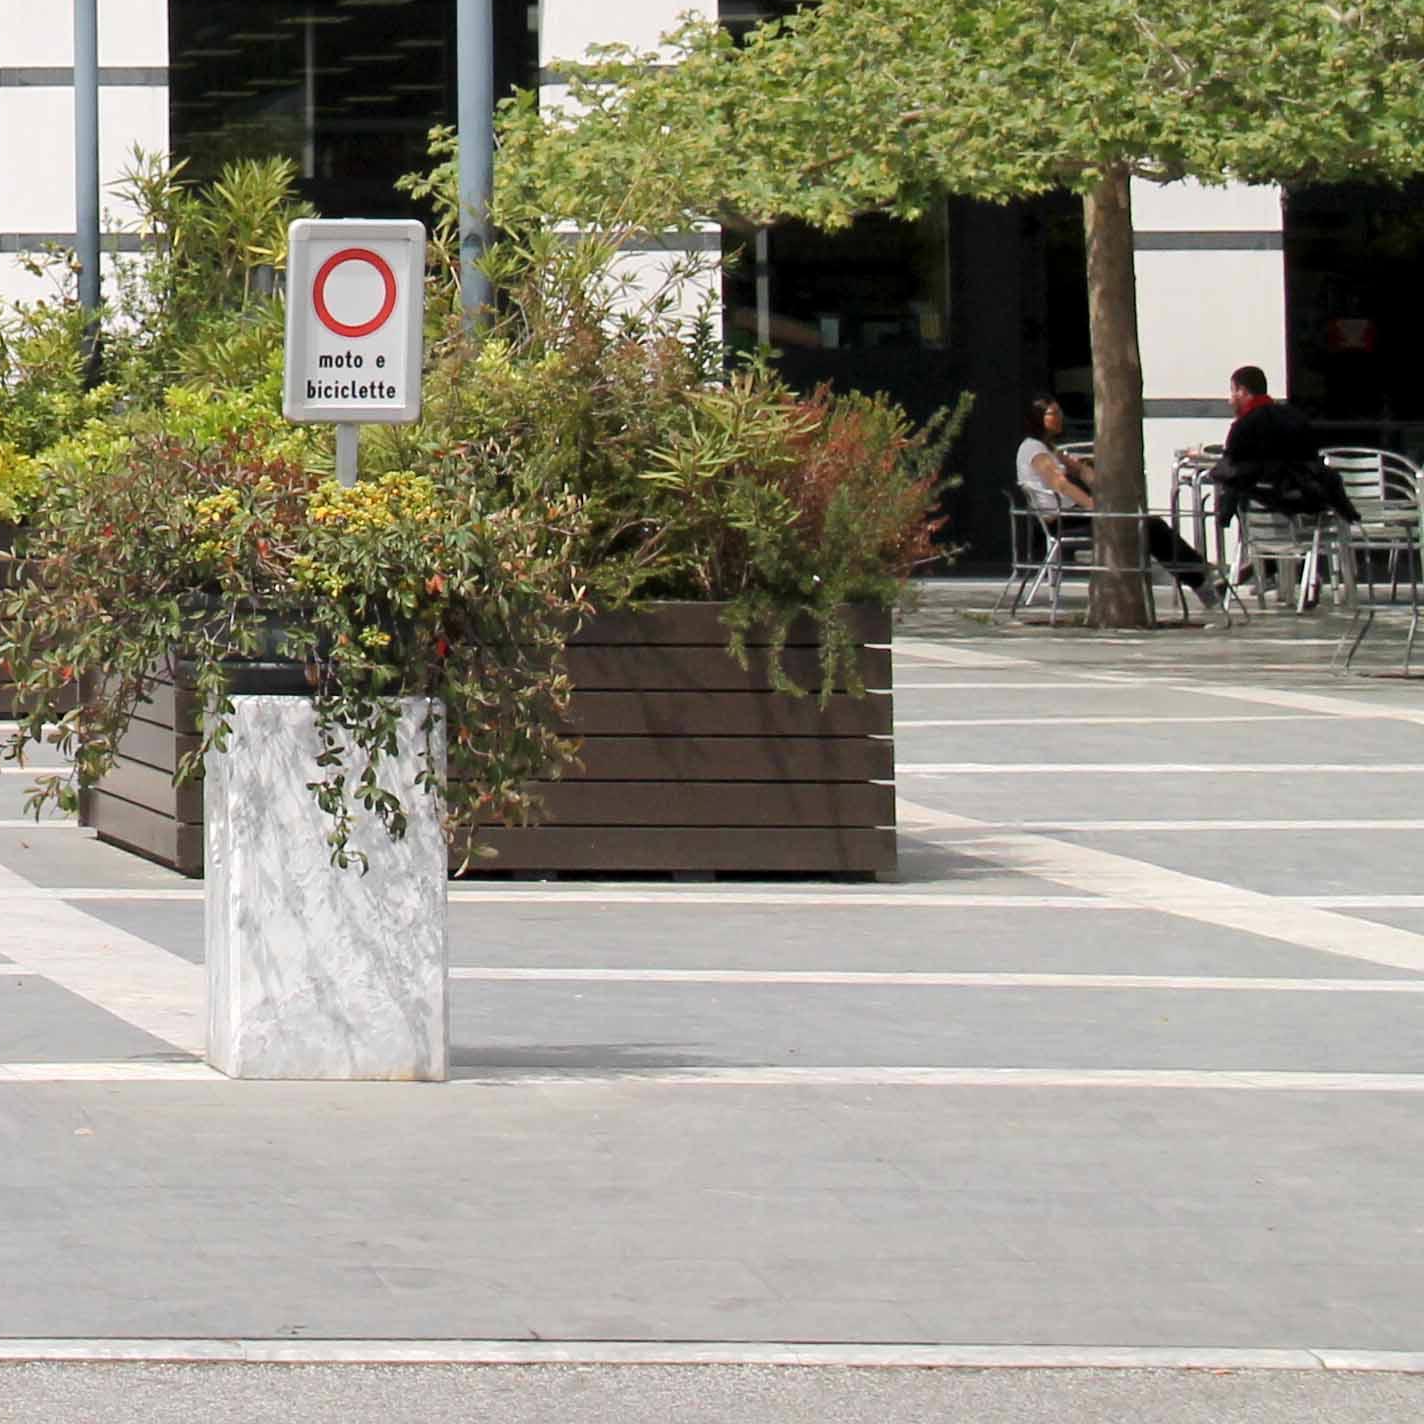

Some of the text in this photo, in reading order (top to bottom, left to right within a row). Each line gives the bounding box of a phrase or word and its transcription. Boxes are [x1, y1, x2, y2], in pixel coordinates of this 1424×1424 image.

[318, 351, 386, 369] moto e
[306, 379, 397, 400] biciclette
